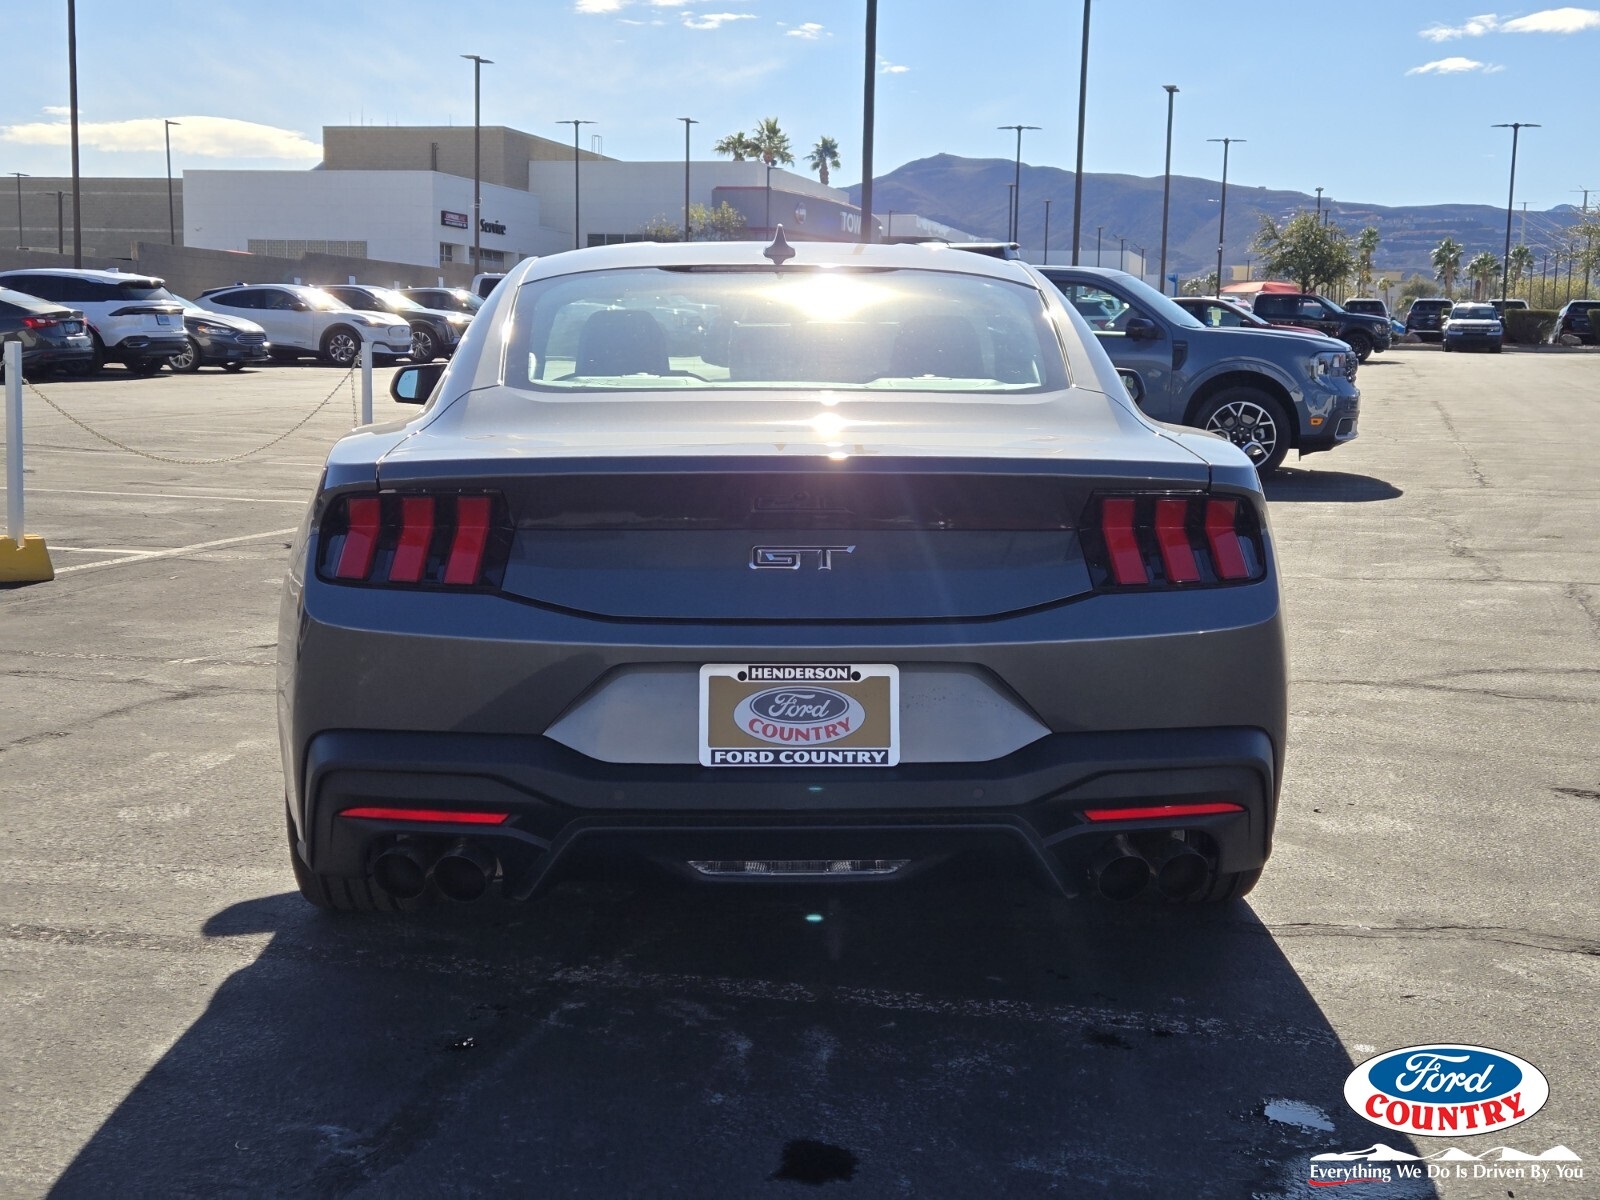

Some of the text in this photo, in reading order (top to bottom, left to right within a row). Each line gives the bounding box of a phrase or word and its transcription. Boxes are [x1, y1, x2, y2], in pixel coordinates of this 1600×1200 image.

[480, 218, 506, 235] Service
[840, 211, 862, 235] TOW
[749, 545, 856, 570] GT
[751, 667, 848, 679] HENDERSON
[768, 692, 831, 718] Ford
[748, 717, 851, 742] COUNTRY
[714, 751, 886, 764] FORD COUNTRY
